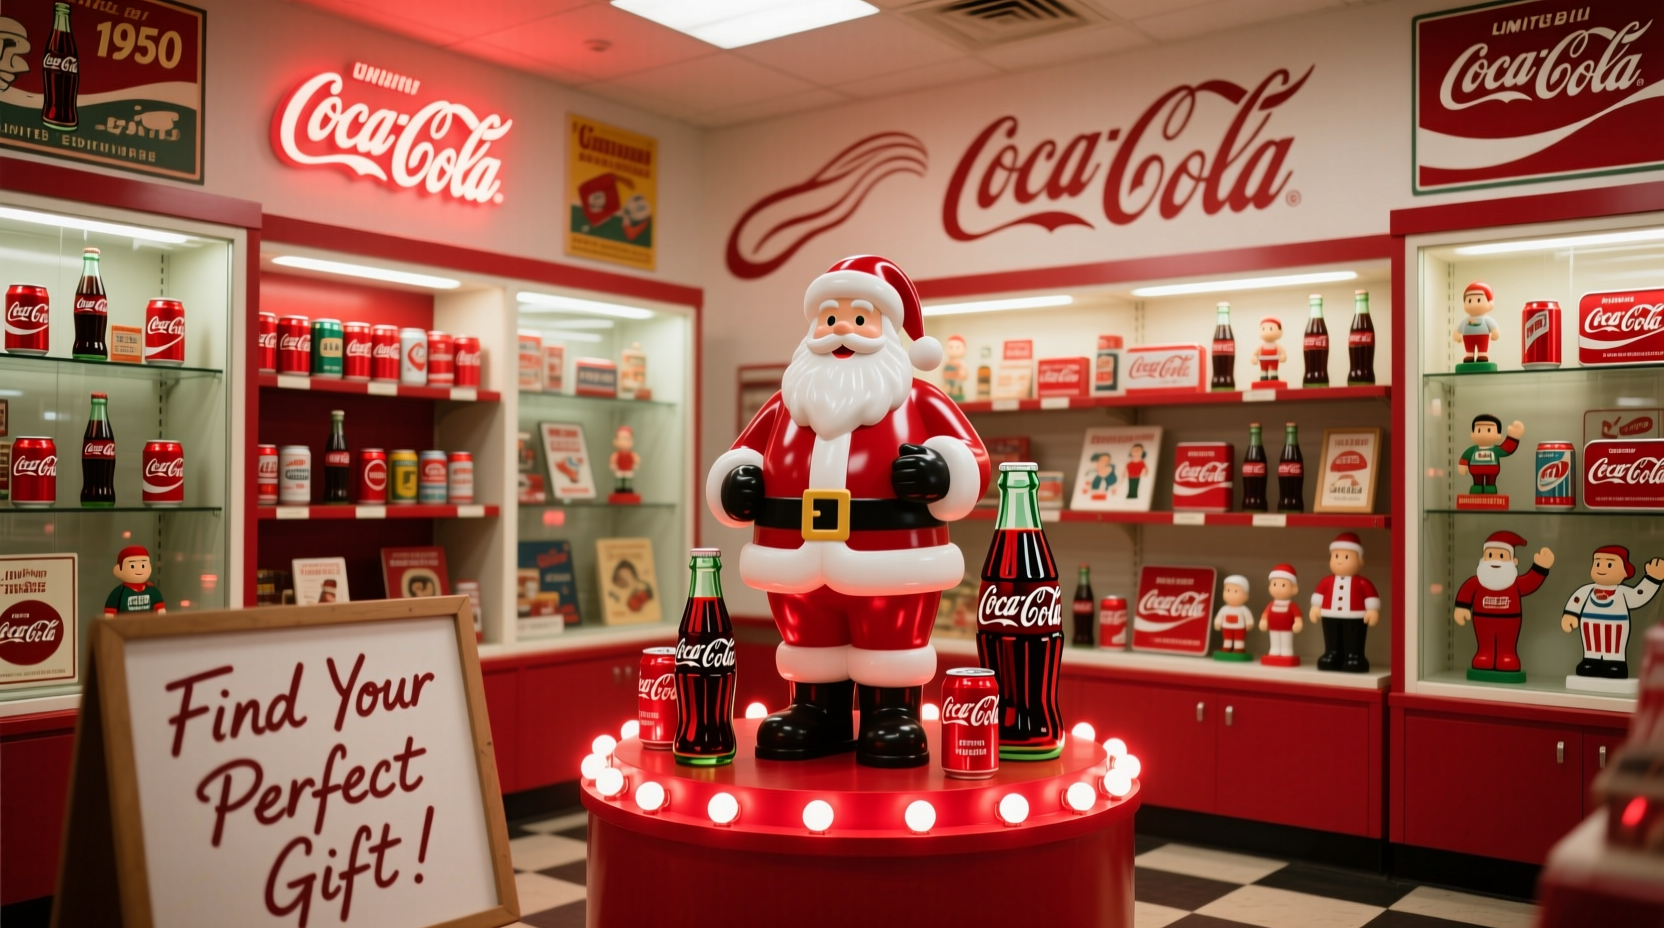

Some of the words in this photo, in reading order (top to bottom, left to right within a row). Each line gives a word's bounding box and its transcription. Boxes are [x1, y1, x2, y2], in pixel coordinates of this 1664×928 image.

[97, 21, 182, 69] 1950
[1440, 19, 1653, 111] Coca-Cola
[281, 72, 513, 204] Coca-Cola
[942, 63, 1315, 242] Coca-Cola
[165, 662, 307, 758] Find
[326, 653, 435, 731] Your
[196, 736, 427, 848] Perfect
